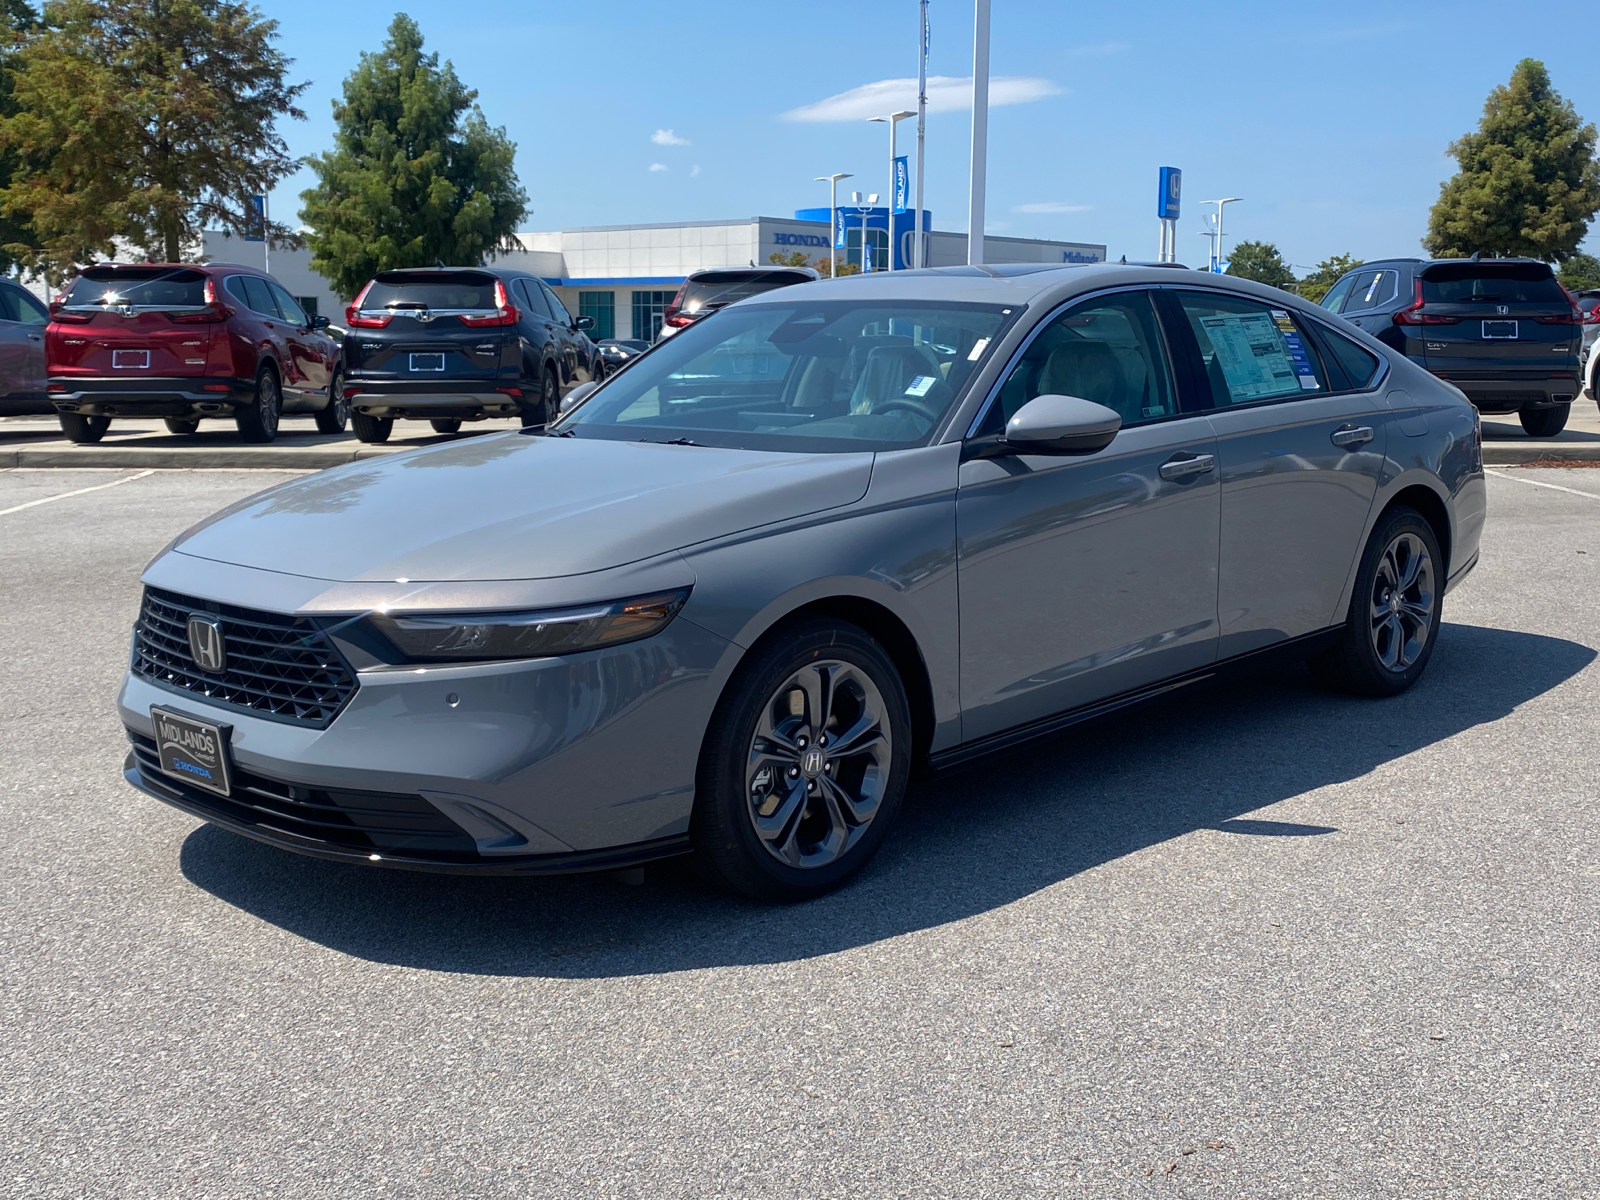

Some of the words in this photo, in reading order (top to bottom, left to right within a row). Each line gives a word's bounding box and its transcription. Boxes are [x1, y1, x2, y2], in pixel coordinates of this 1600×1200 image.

[774, 232, 831, 248] HONDA
[1063, 251, 1099, 264] Midlands
[159, 720, 214, 754] MIDLANDS
[180, 761, 212, 779] HONDA
